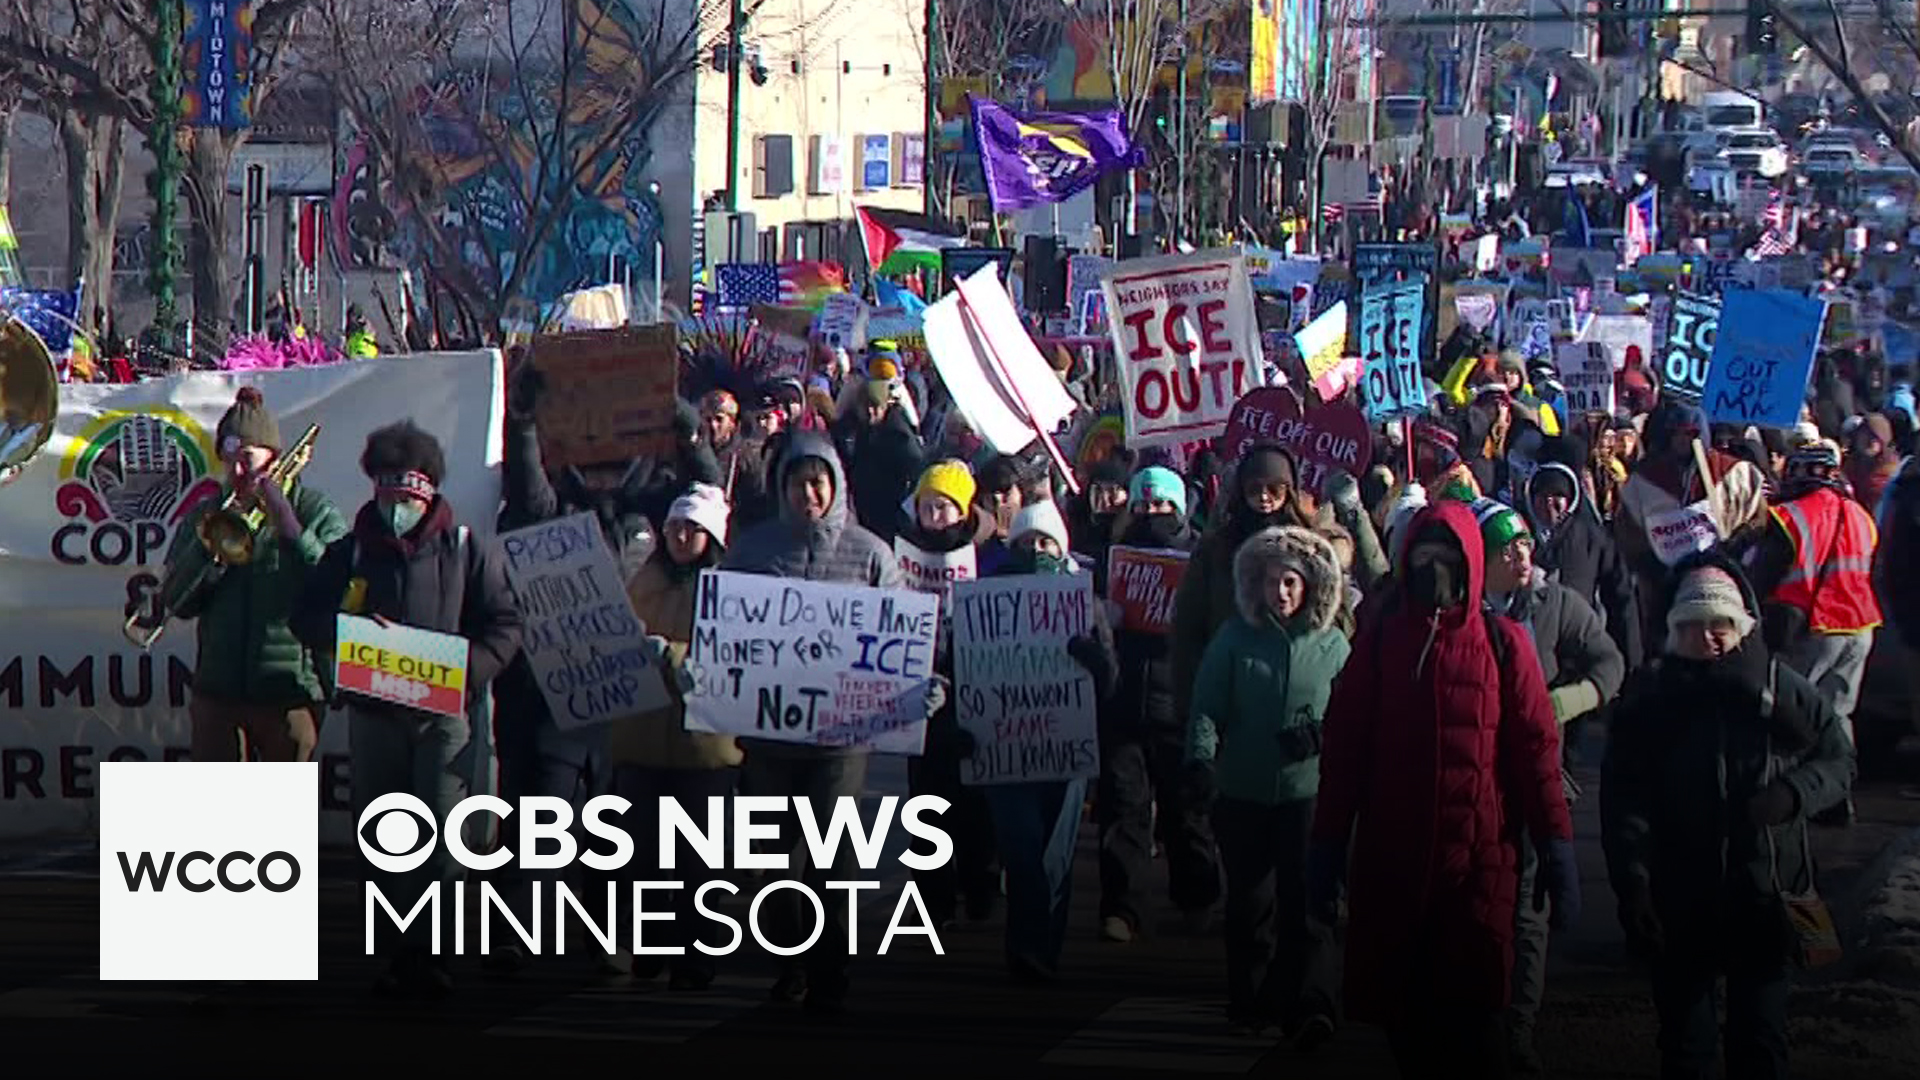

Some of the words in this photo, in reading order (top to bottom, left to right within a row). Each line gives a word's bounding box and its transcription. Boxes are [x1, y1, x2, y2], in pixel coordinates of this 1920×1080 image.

[208, 2, 225, 122] MIDTOWN
[1124, 299, 1232, 361] ICE
[1364, 314, 1411, 360] ICE
[1670, 313, 1717, 352] IC
[1136, 358, 1246, 420] OUT!
[1666, 350, 1711, 388] OU
[1726, 356, 1780, 381] OUT
[1316, 432, 1357, 465] OUR
[52, 522, 167, 565] COP
[826, 598, 864, 630] WE
[964, 587, 1022, 642] THEY
[350, 642, 391, 668] ICE
[398, 655, 452, 685] OUT
[851, 634, 928, 681] ICE
[567, 675, 639, 720] CAMP
[958, 683, 985, 720] SO
